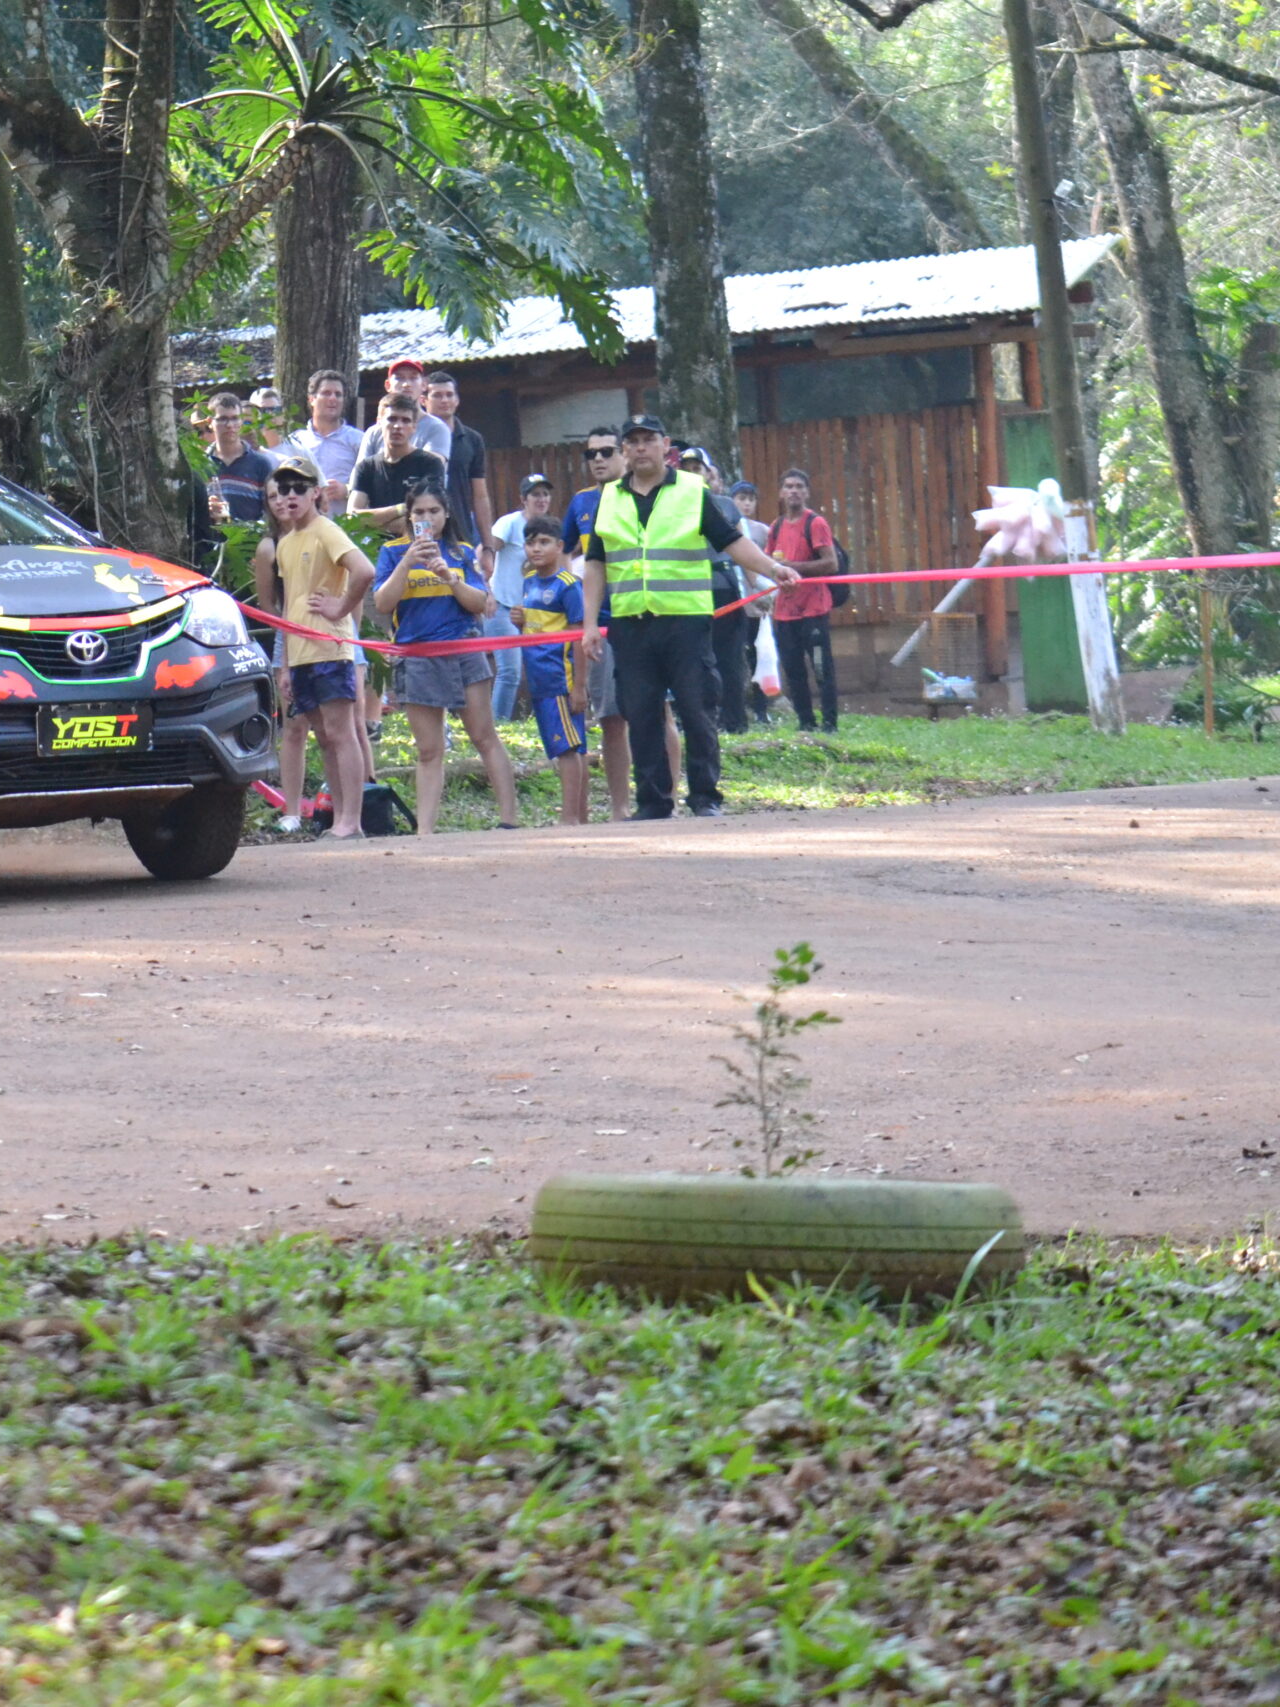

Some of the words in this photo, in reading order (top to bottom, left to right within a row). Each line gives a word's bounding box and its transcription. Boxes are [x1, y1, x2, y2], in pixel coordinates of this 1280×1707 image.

[408, 577, 458, 589] bets
[52, 714, 138, 739] YOST
[52, 736, 137, 749] COMPETICION
